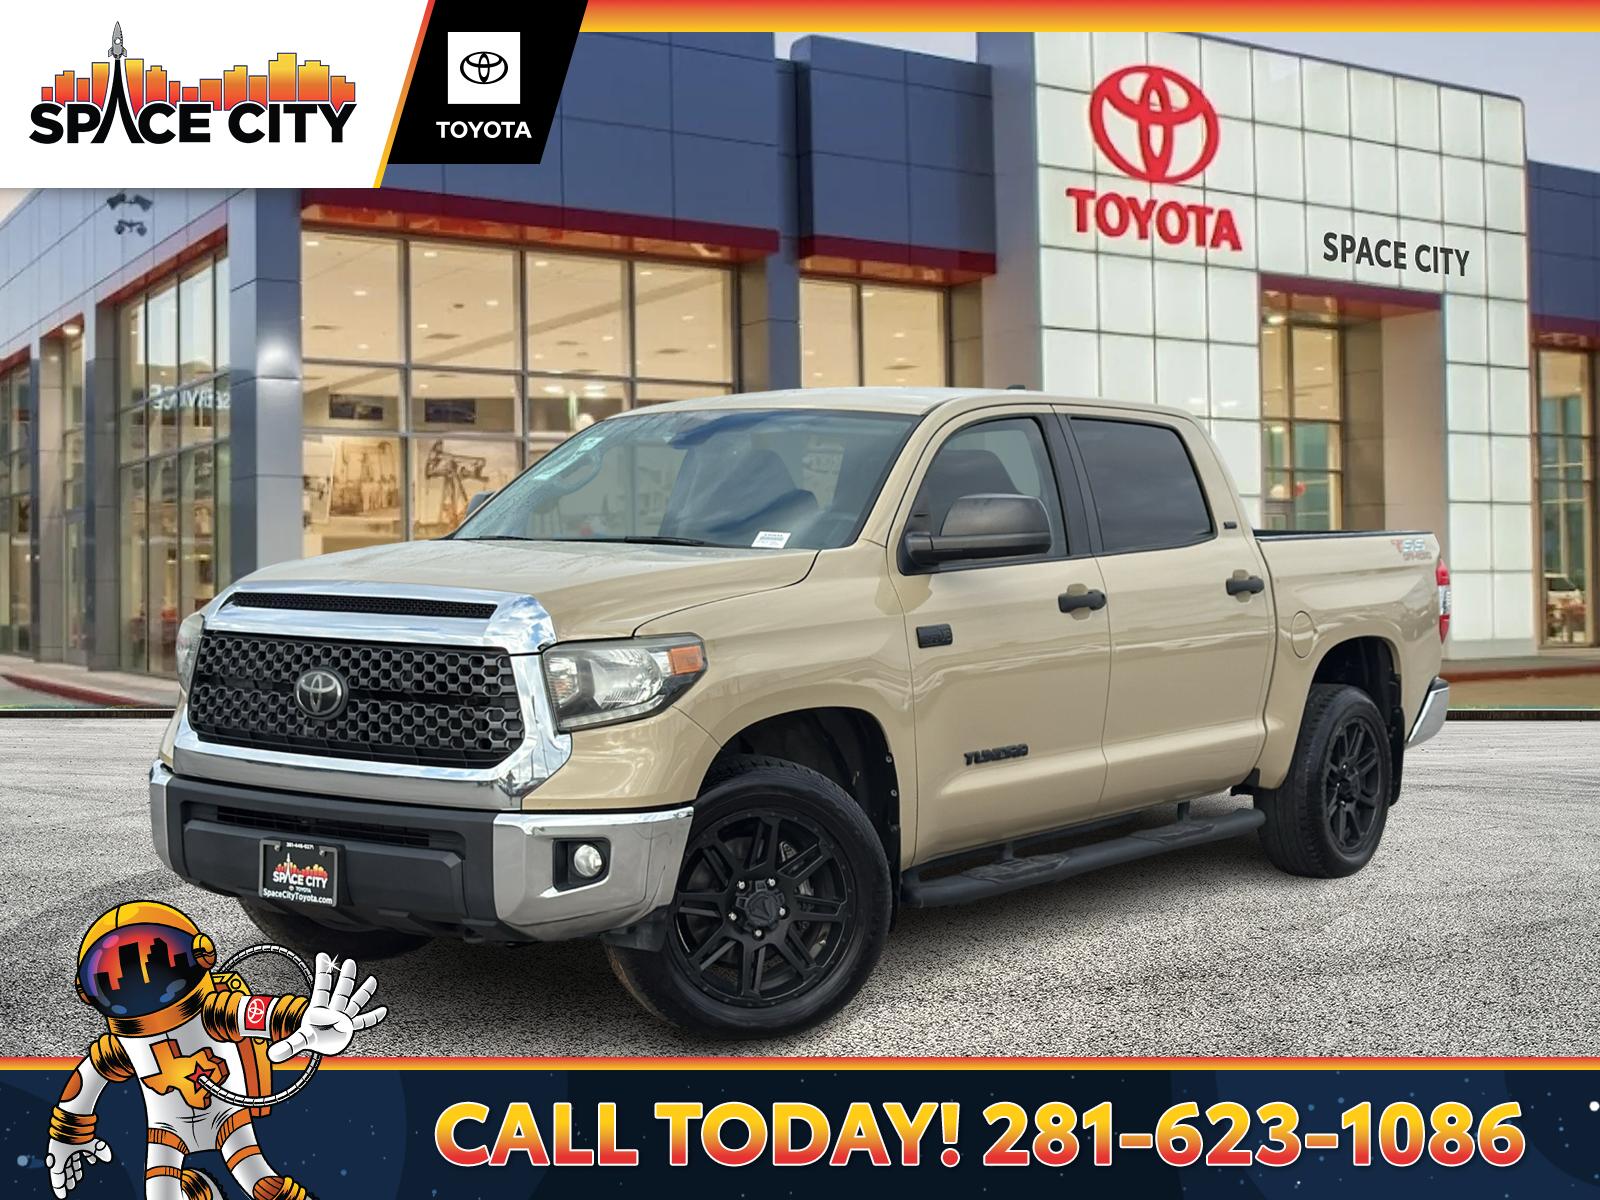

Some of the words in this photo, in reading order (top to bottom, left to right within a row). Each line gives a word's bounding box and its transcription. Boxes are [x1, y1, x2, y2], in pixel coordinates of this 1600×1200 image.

[1066, 187, 1243, 252] TOYOTA
[1323, 232, 1407, 271] SPACE
[1414, 243, 1470, 277] CITY
[273, 870, 304, 885] SPACE
[305, 876, 328, 888] CITY
[263, 888, 333, 904] SpaceCityToyota.com
